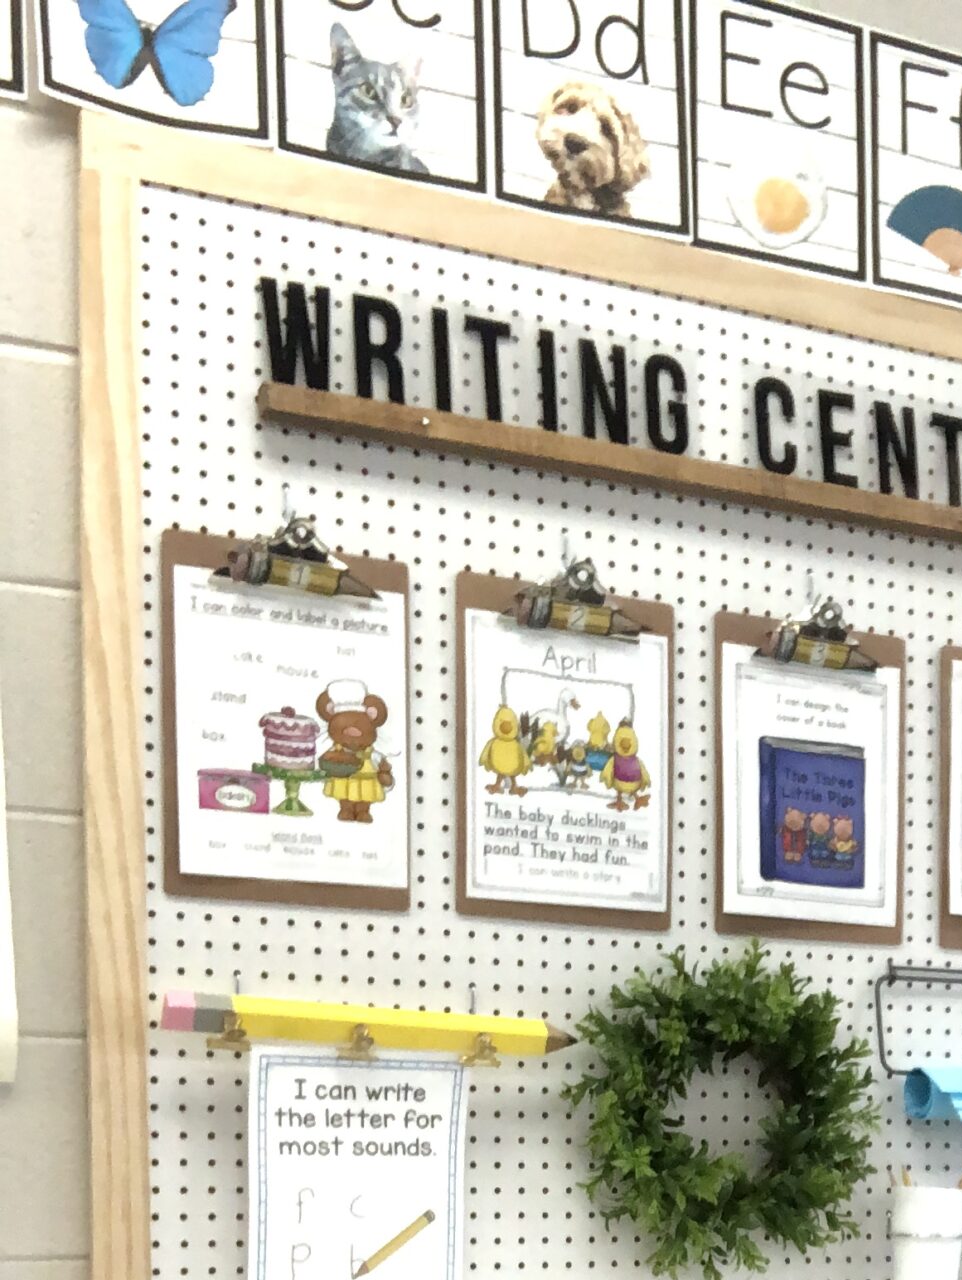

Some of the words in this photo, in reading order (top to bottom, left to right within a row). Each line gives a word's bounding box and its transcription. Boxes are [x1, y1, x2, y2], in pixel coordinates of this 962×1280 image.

[719, 9, 832, 131] Ee
[258, 276, 692, 456] WRITING
[203, 601, 228, 613] can
[297, 607, 327, 626] label
[343, 617, 389, 634] picture
[542, 645, 598, 679] April
[484, 801, 513, 821] The
[518, 807, 555, 827] baby
[561, 809, 627, 834] ducklings
[484, 824, 539, 841] wanted
[545, 827, 560, 843] to
[566, 831, 603, 846] swim
[608, 833, 621, 849] in
[626, 834, 649, 850] the
[531, 841, 566, 863] They
[572, 847, 599, 864] had
[605, 851, 632, 867] fun.
[294, 1078, 307, 1100] I
[315, 1082, 356, 1101] can
[366, 1082, 426, 1102] write
[275, 1107, 316, 1128] the
[325, 1108, 395, 1129] letter
[404, 1109, 442, 1129] for
[279, 1136, 344, 1156] most
[352, 1137, 437, 1156] sounds.
[296, 1187, 315, 1224] f
[350, 1194, 366, 1218] c
